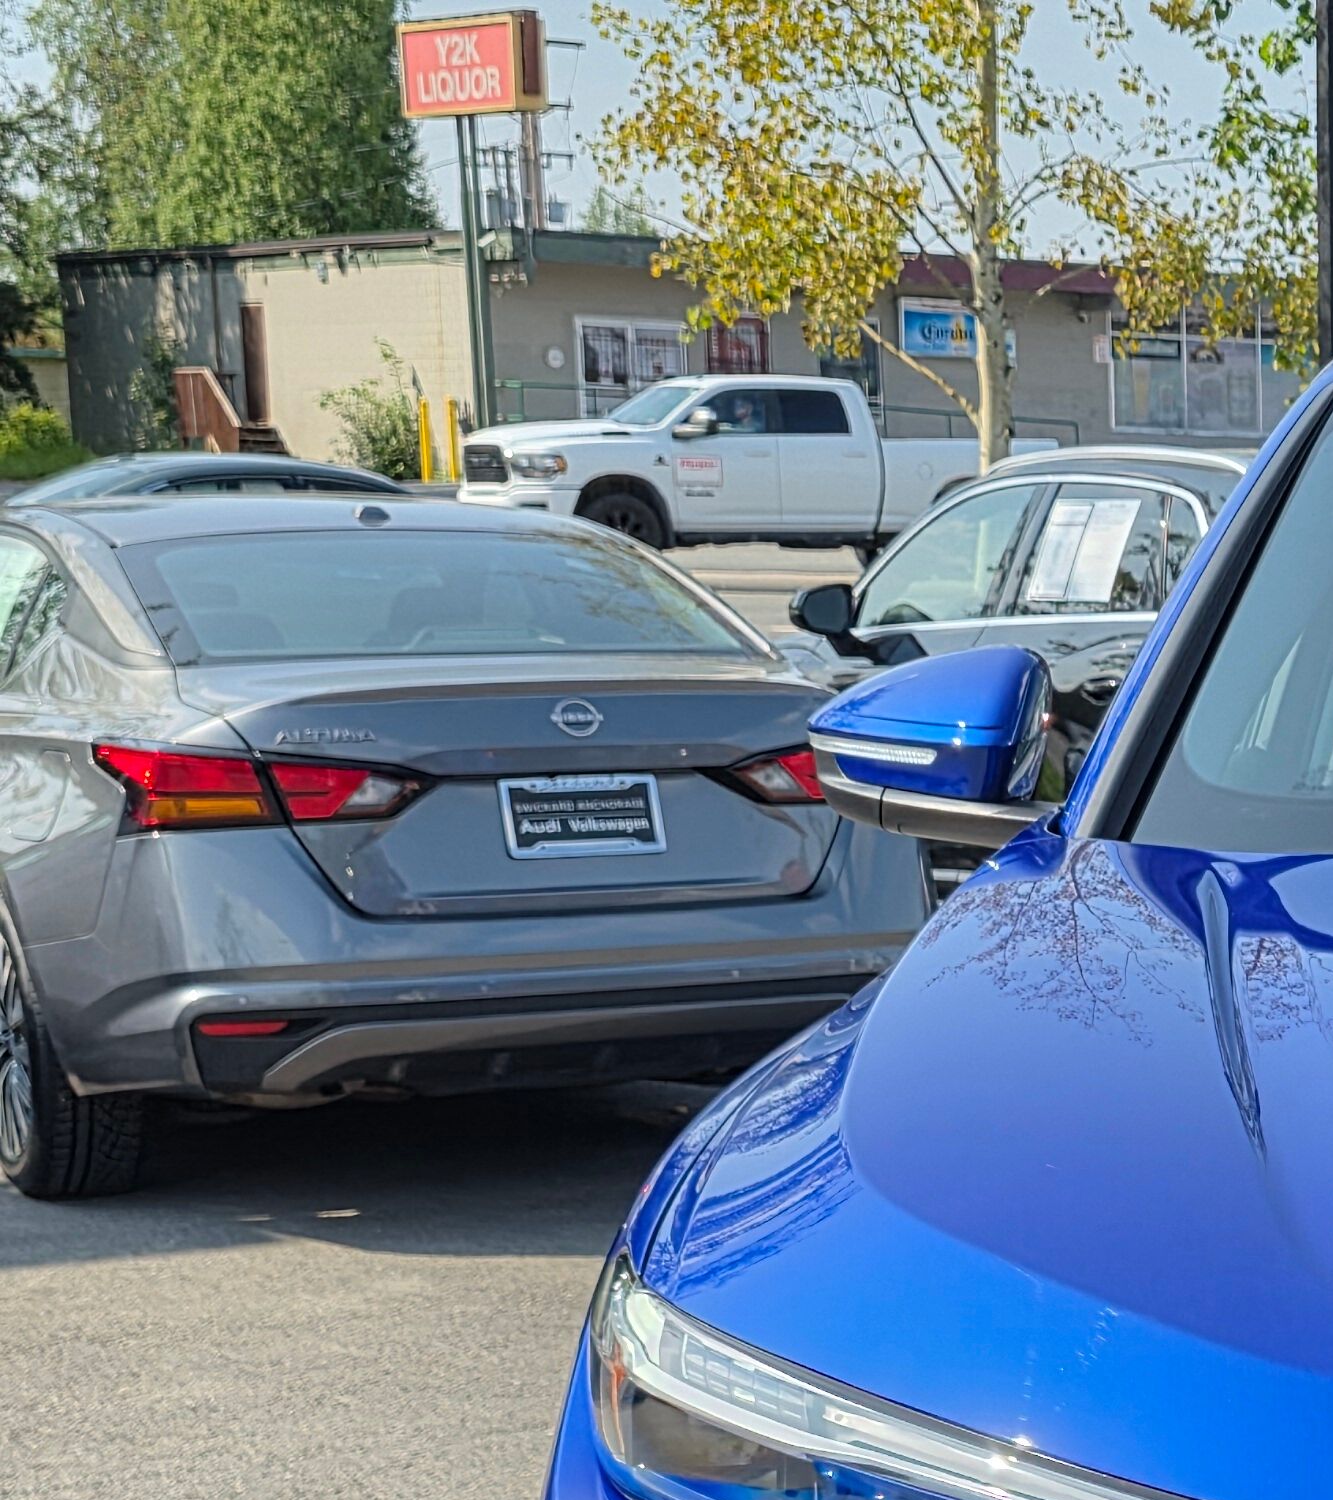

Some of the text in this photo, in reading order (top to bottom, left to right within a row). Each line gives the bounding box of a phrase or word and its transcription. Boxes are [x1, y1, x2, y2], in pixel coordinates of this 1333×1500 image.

[434, 31, 480, 66] Y2K
[416, 64, 501, 104] LIQUOR
[519, 817, 561, 835] Audi
